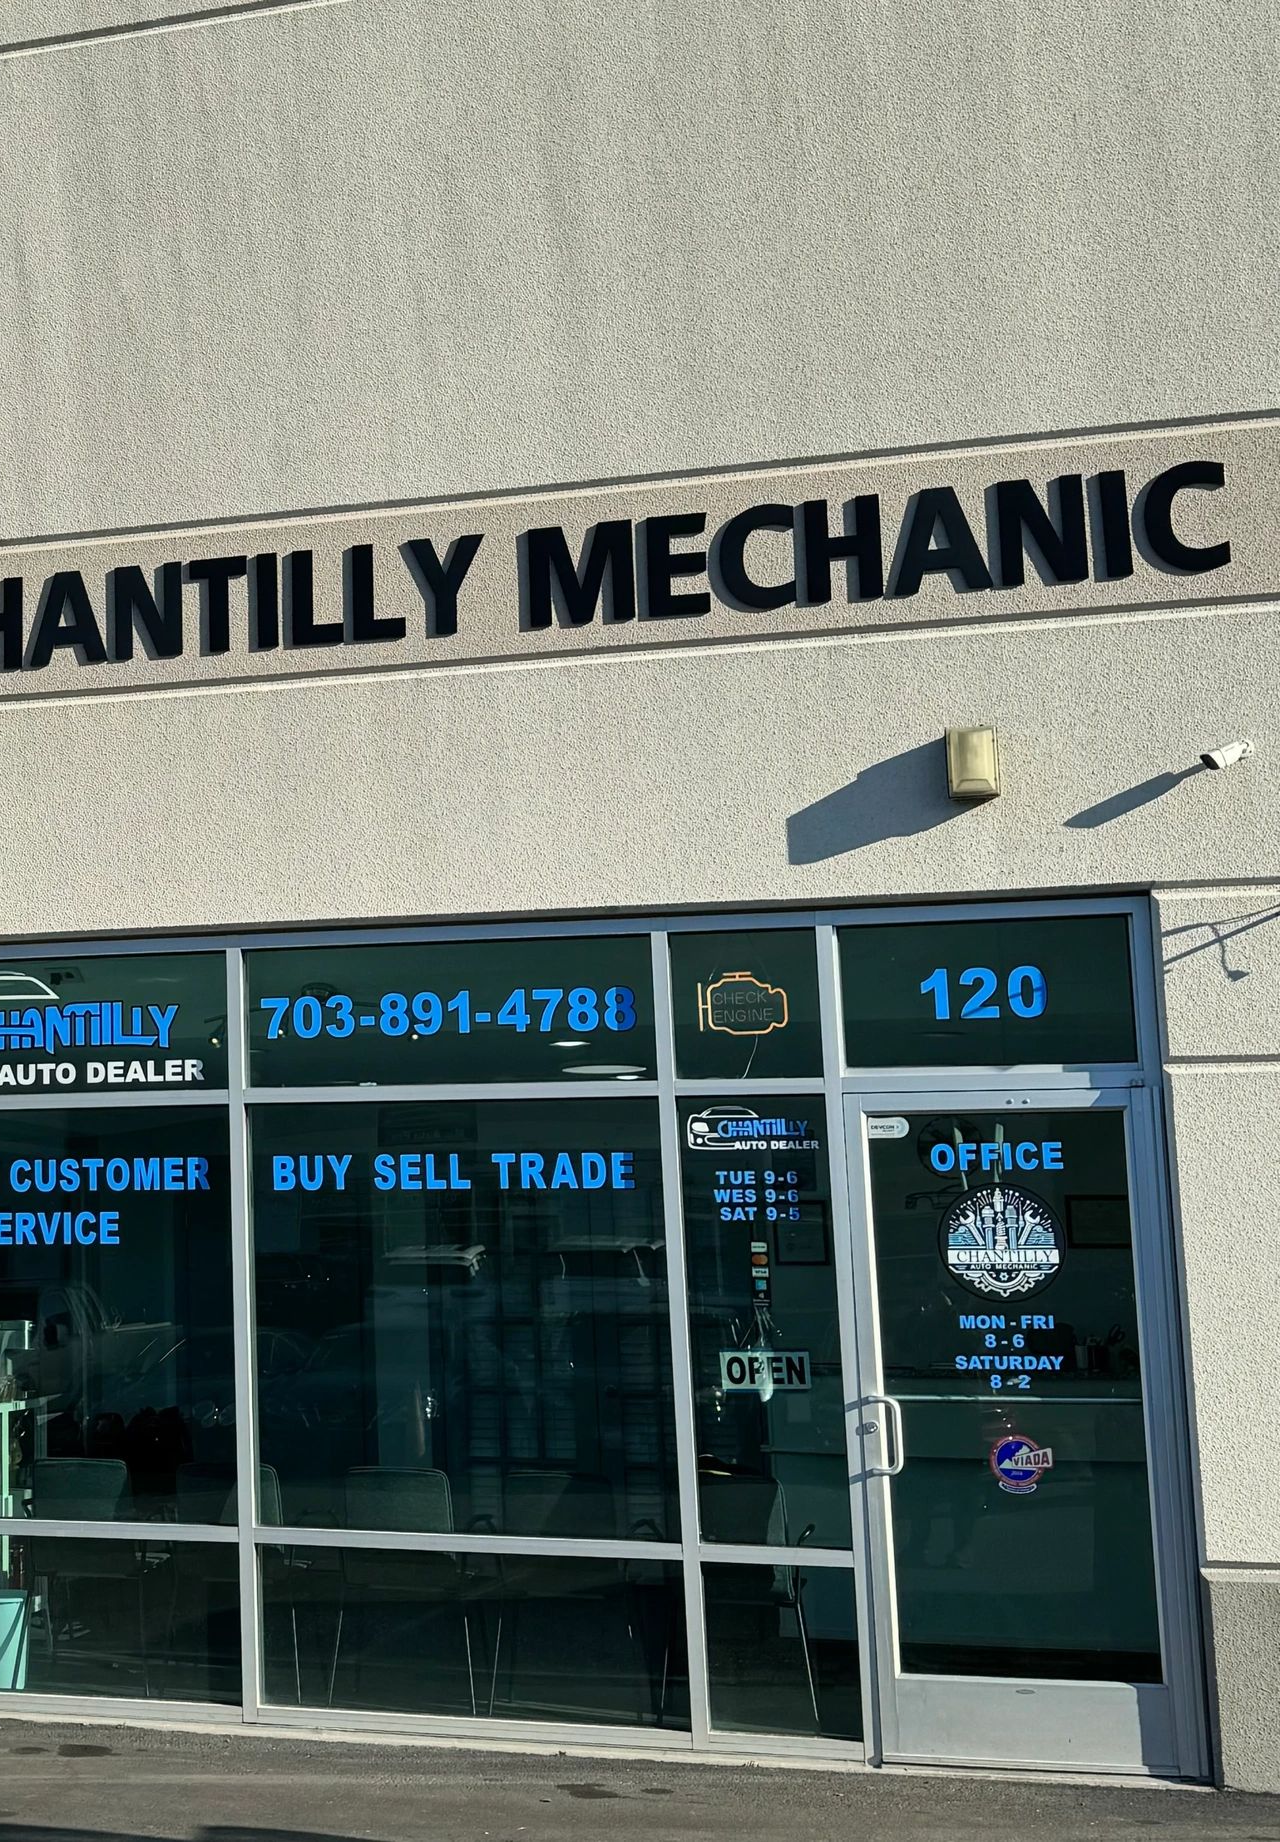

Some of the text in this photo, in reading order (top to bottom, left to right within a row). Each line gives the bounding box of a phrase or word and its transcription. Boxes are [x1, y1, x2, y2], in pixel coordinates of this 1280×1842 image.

[519, 461, 1231, 632] MECHANIC
[712, 990, 767, 1006] CHECK
[920, 965, 1048, 1020] 120
[260, 986, 636, 1039] 703-891-4788
[714, 1007, 773, 1024] ENGINE
[87, 1059, 204, 1083] DEALER
[717, 1119, 808, 1138] CHANTILLY
[734, 1140, 819, 1150] AUTO DEALER
[930, 1141, 1064, 1172] OFFICE
[10, 1157, 210, 1192] CUSTOMER
[272, 1152, 635, 1191] BUY SELL TRADE
[715, 1171, 756, 1185] TUE
[714, 1189, 757, 1203] WES
[720, 1207, 757, 1221] SAT
[957, 1250, 1053, 1263] CHANTILLY
[959, 1315, 1005, 1329] MON
[1021, 1315, 1054, 1329] FRI
[726, 1356, 807, 1385] OPEN
[955, 1355, 1064, 1370] SATURDAY
[1013, 1451, 1050, 1466] VIADA
